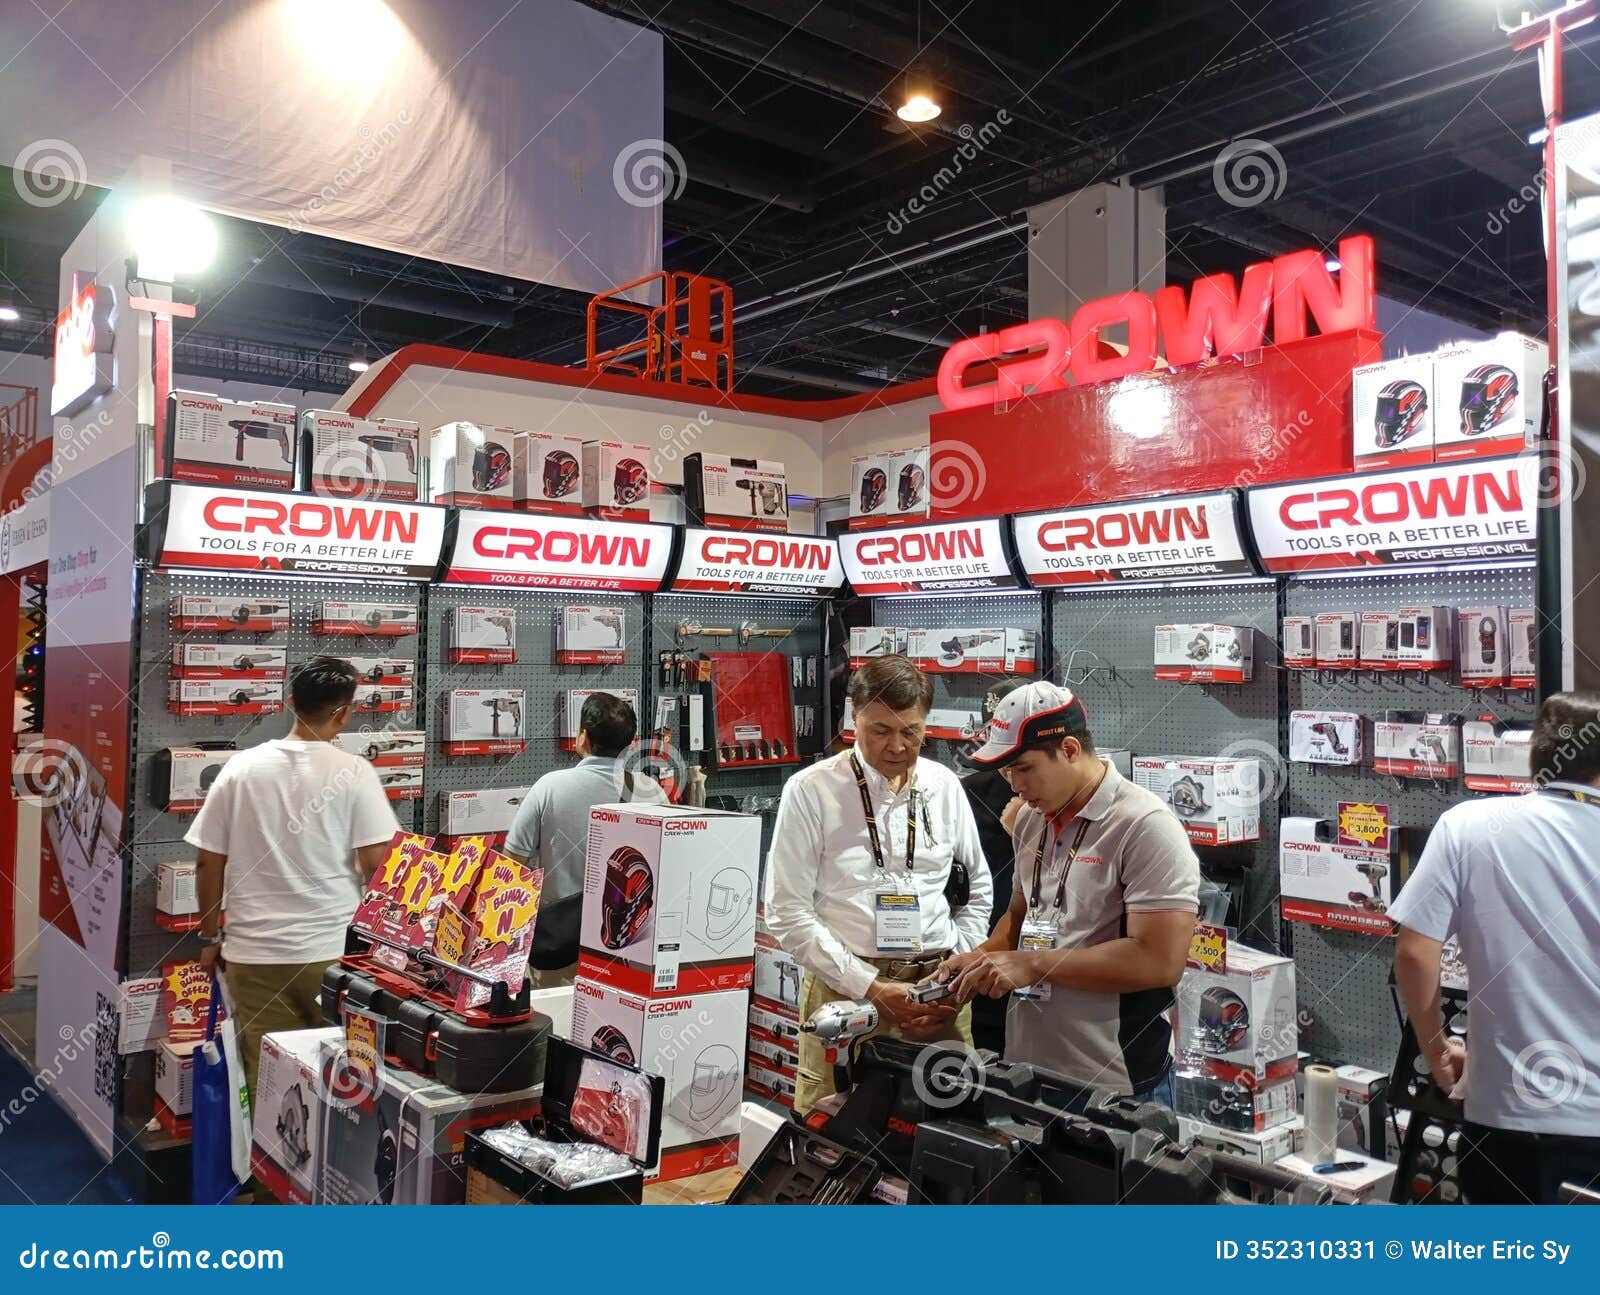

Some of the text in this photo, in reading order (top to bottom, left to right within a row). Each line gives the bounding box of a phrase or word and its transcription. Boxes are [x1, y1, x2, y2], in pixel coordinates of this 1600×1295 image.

[937, 235, 1375, 411] CROWN
[181, 400, 223, 412] CROWN
[318, 418, 355, 429] CROWN
[704, 464, 728, 474] CROWN
[1279, 469, 1524, 531] CROWN
[203, 496, 418, 544] CROWN
[1037, 505, 1210, 552] CROWN
[1285, 519, 1530, 551] TOOLS FOR A BETTER LIFE
[199, 536, 414, 560] TOOLS FOR A BETTER LIFE
[473, 526, 650, 567] CROWN
[701, 536, 832, 570] CROWN
[856, 528, 985, 566] CROWN
[1392, 543, 1536, 561] PROFESSIONAL
[1043, 546, 1216, 569] TOOLS FOR A BETTER LIFE
[294, 561, 408, 575] PROFESSIONAL
[696, 567, 826, 584] TOOLS FOR A BETTER LIFE
[861, 562, 990, 580] TOOLS FOR A BETTER LIFE
[1121, 566, 1223, 578] PROFESSIONAL
[490, 574, 620, 589] TOOLS FOR A BETTER LIFE
[748, 584, 818, 595] PROFESSIONAL
[920, 578, 997, 590] PROFESSIONAL
[1135, 761, 1165, 769] CROWN
[591, 811, 620, 823] CROWN
[665, 820, 708, 831] CROWN
[1283, 842, 1321, 852] CROWN
[1075, 856, 1103, 865] CROWN
[493, 888, 531, 912] BUNDLE
[496, 908, 514, 937] N
[182, 986, 210, 998] OFFER
[576, 982, 604, 1000] CROWN
[648, 1000, 692, 1014] CROWN
